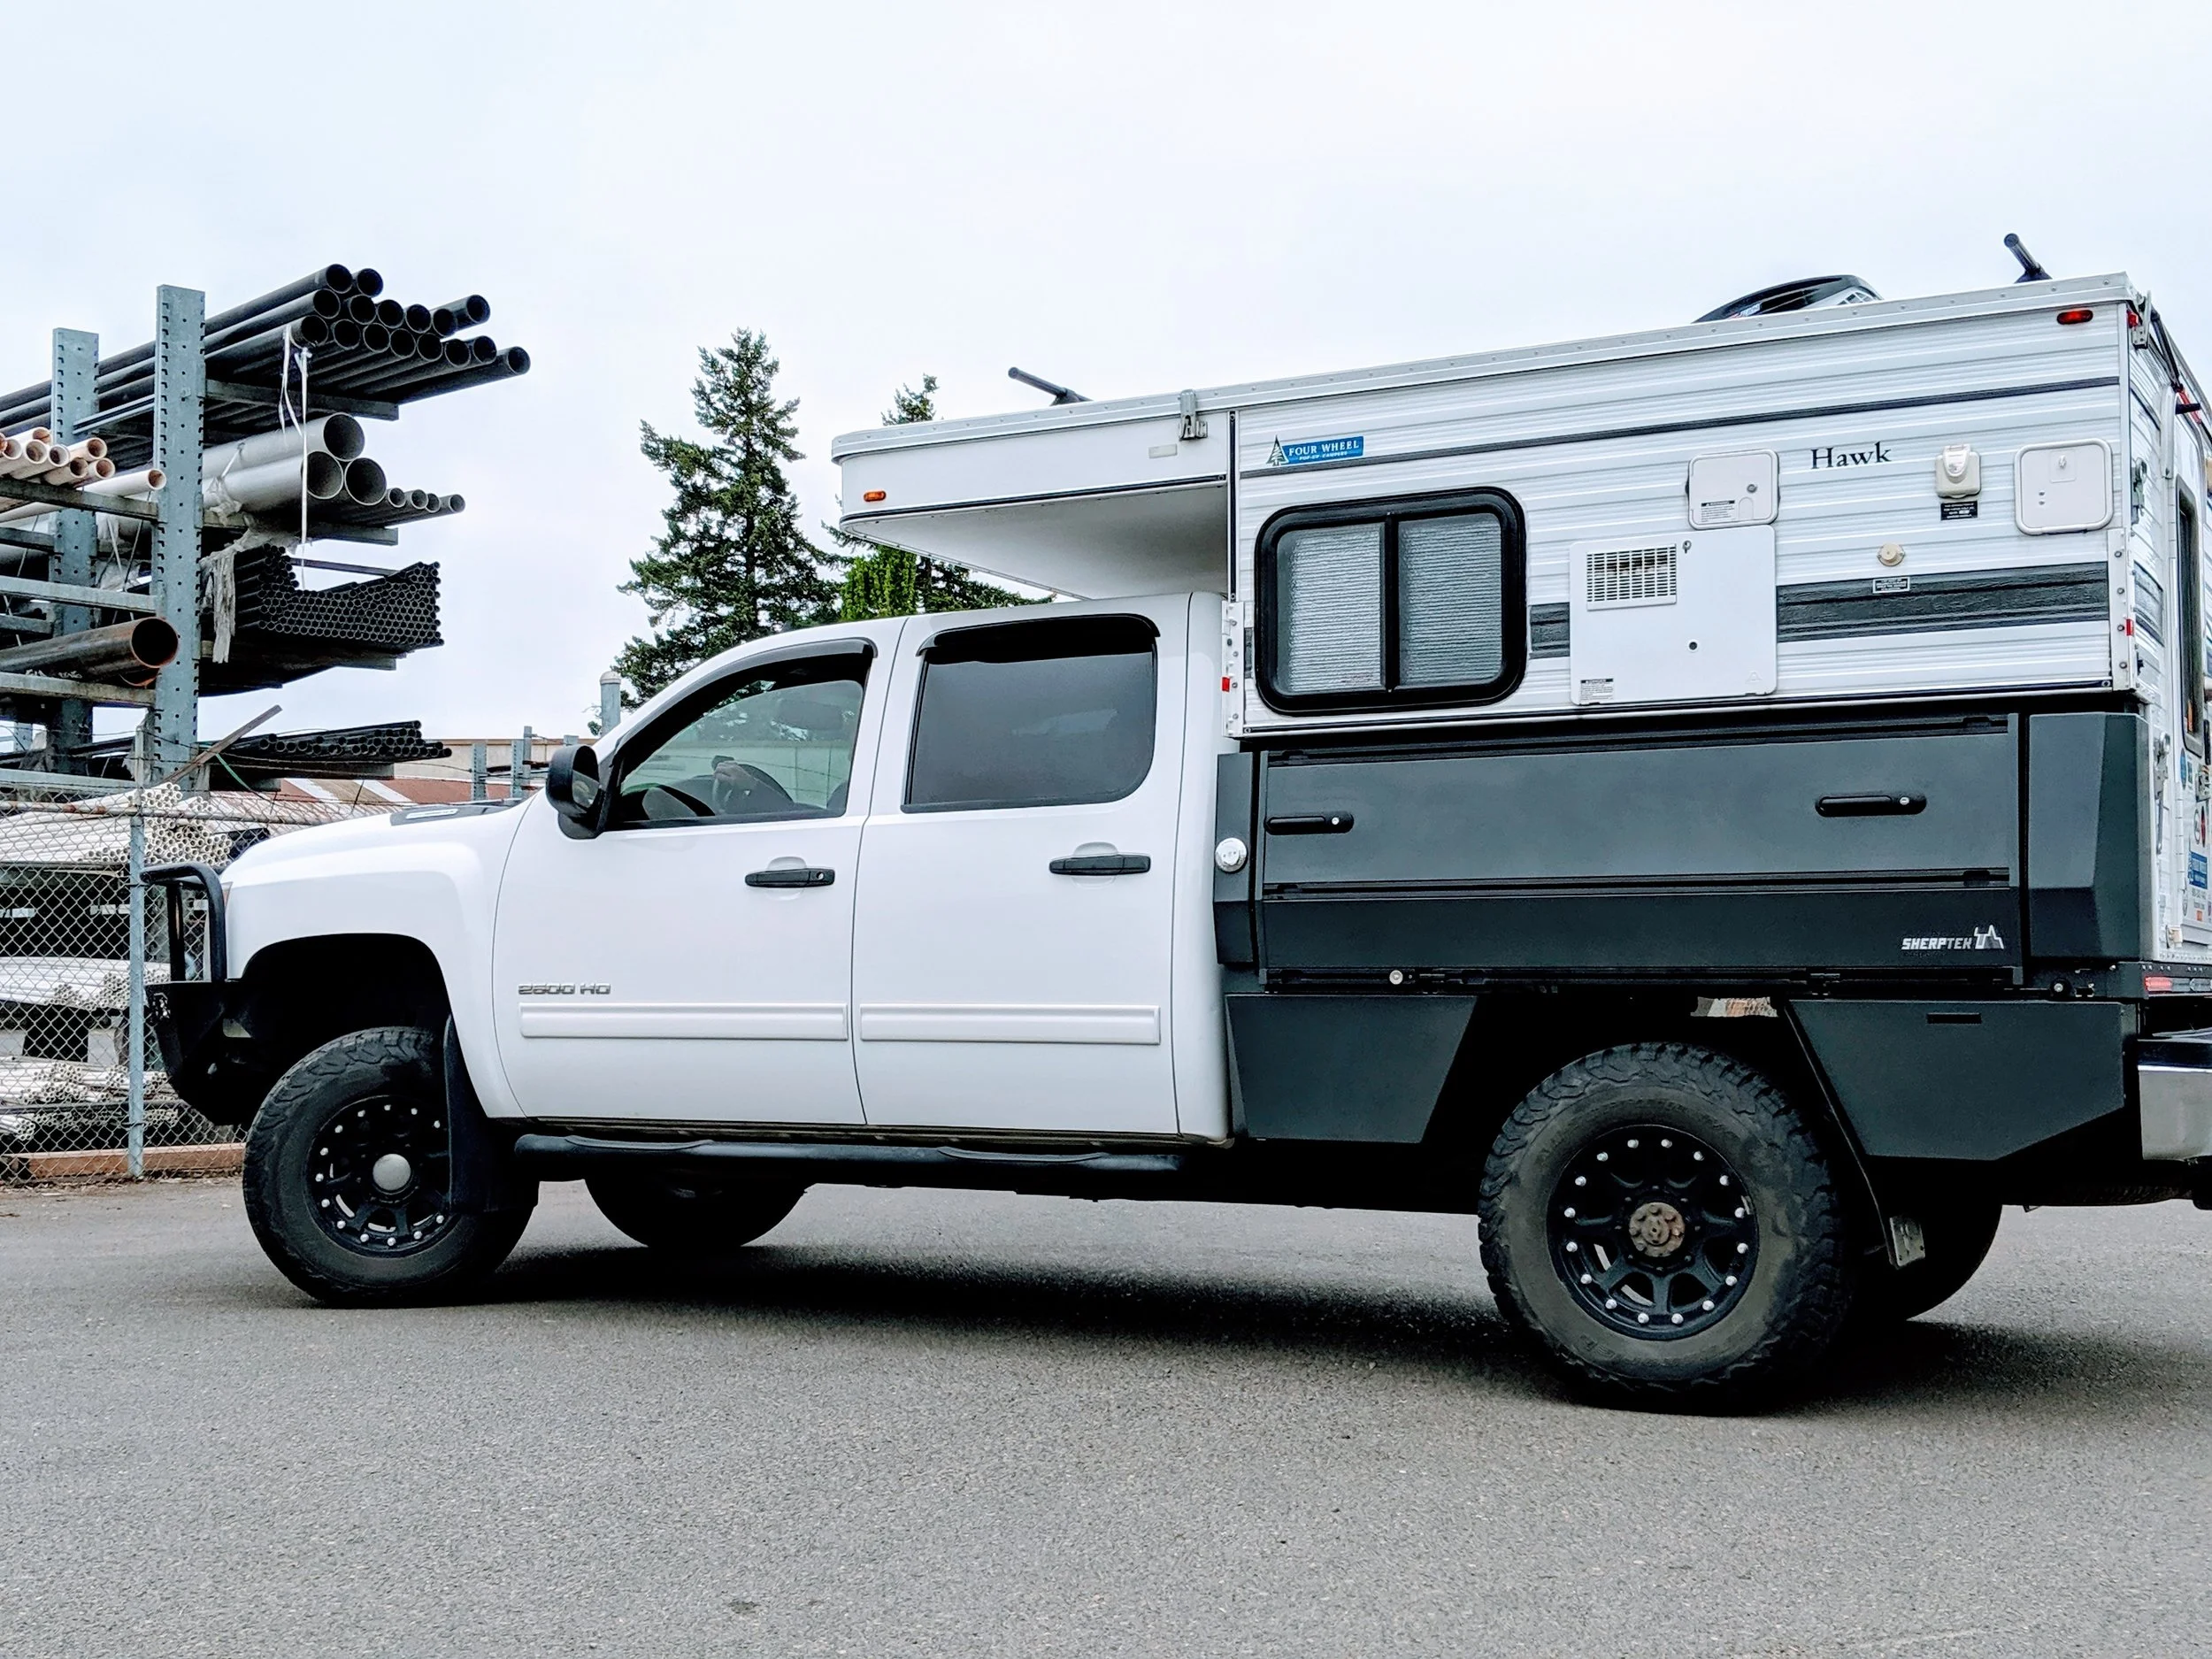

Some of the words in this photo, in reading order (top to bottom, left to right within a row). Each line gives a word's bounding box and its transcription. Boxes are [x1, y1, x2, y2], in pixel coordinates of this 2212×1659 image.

[1288, 445, 1317, 457] FOUR
[1321, 440, 1360, 453] WHEEL
[1810, 441, 1892, 470] Hawk
[1901, 937, 1973, 950] SHERPTEK
[518, 984, 576, 995] 2500
[580, 984, 611, 995] HD
